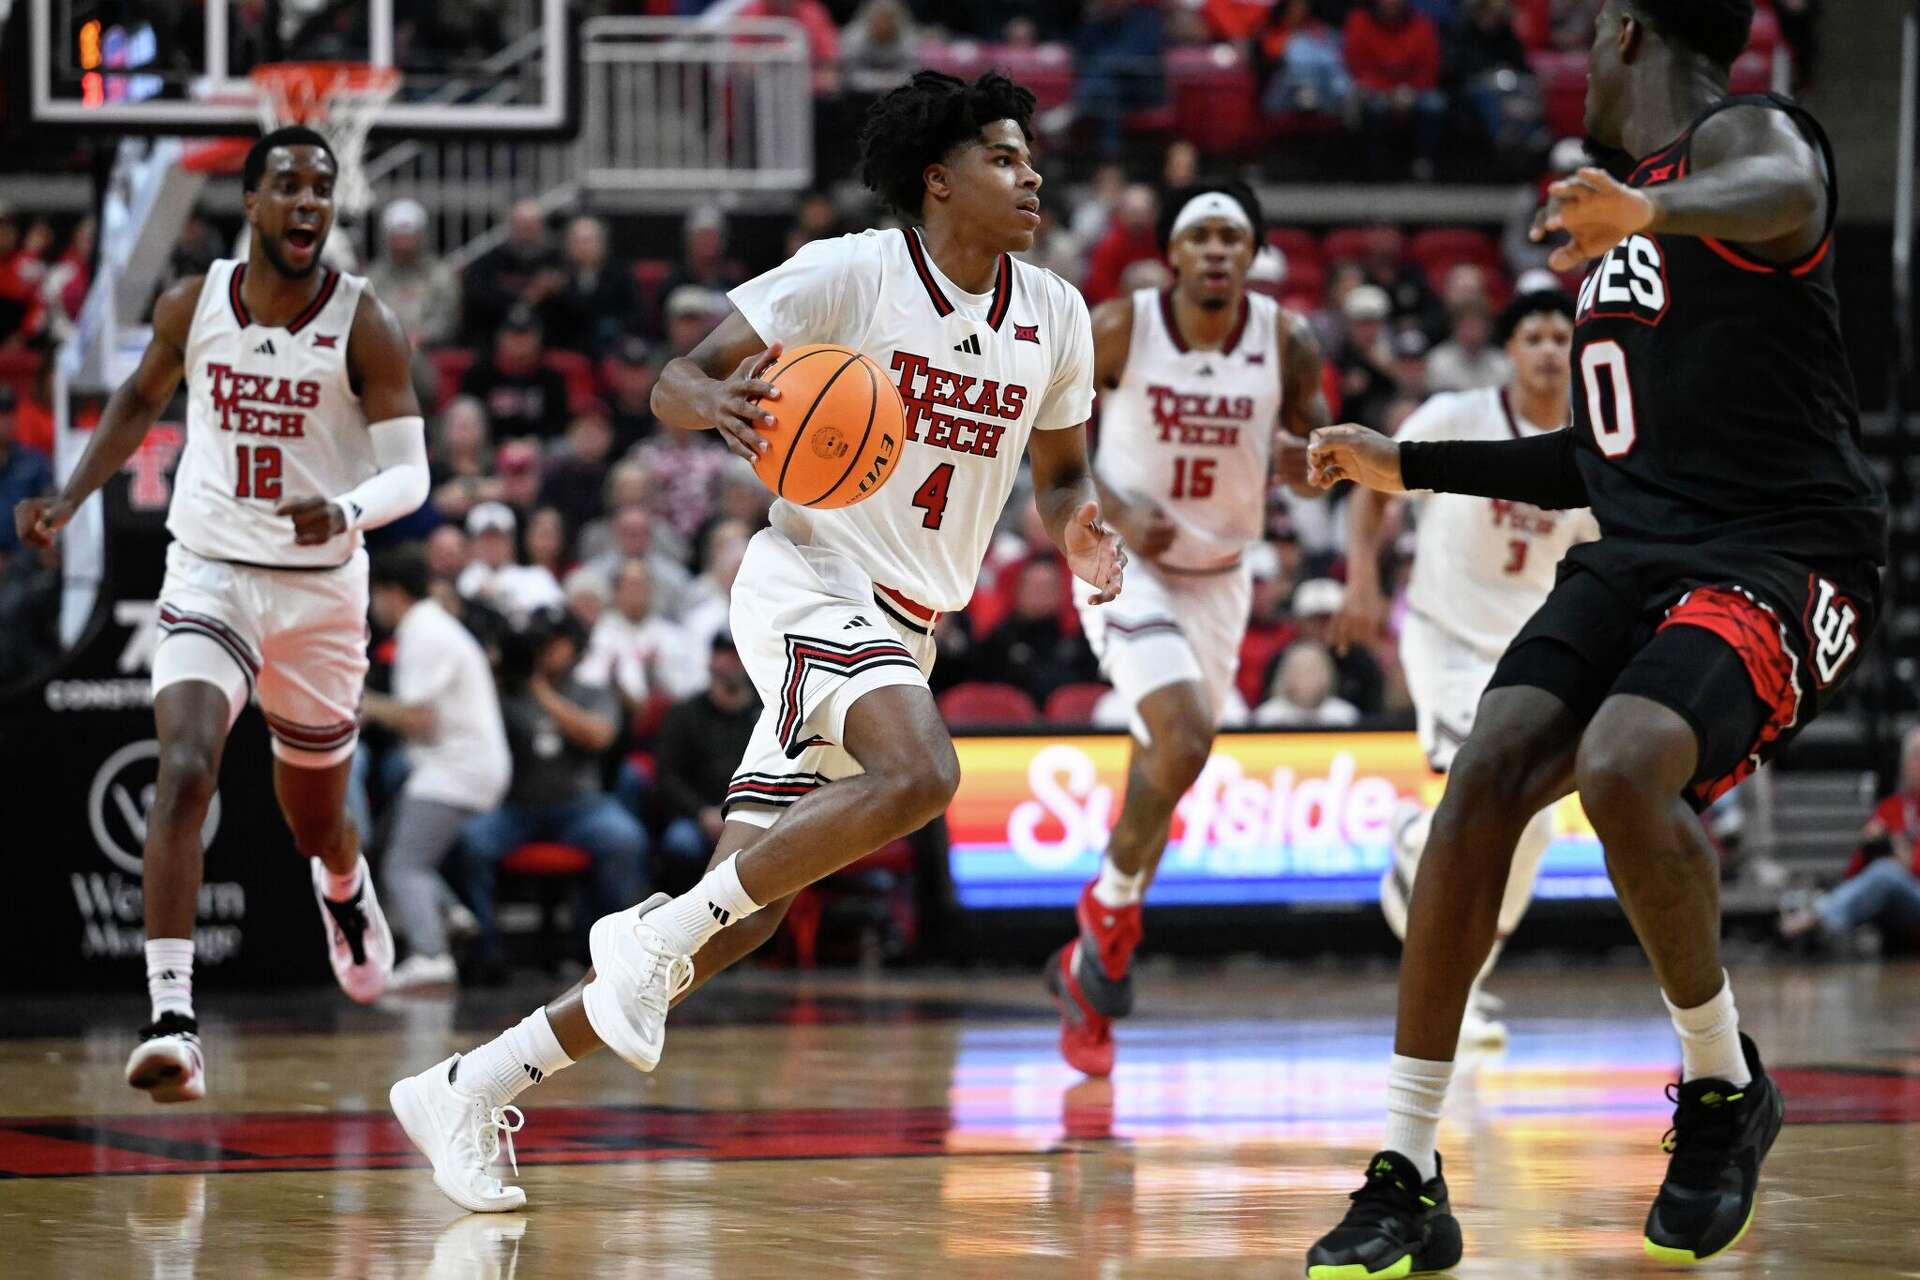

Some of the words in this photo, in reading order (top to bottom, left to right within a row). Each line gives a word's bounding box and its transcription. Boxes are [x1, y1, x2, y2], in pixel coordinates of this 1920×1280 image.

[207, 362, 321, 409] TEXAS
[889, 350, 1028, 421] TEXAS
[1146, 384, 1253, 422] TEXAS
[1581, 340, 1636, 458] 0
[213, 397, 306, 438] TECH
[904, 399, 1006, 458] TECH
[1155, 414, 1240, 447] TECH
[235, 444, 282, 499] 12
[858, 432, 895, 493] EVO
[1170, 455, 1217, 499] 15
[912, 462, 955, 530] 4
[1504, 539, 1529, 575] 3
[1008, 744, 1396, 870] Sfside
